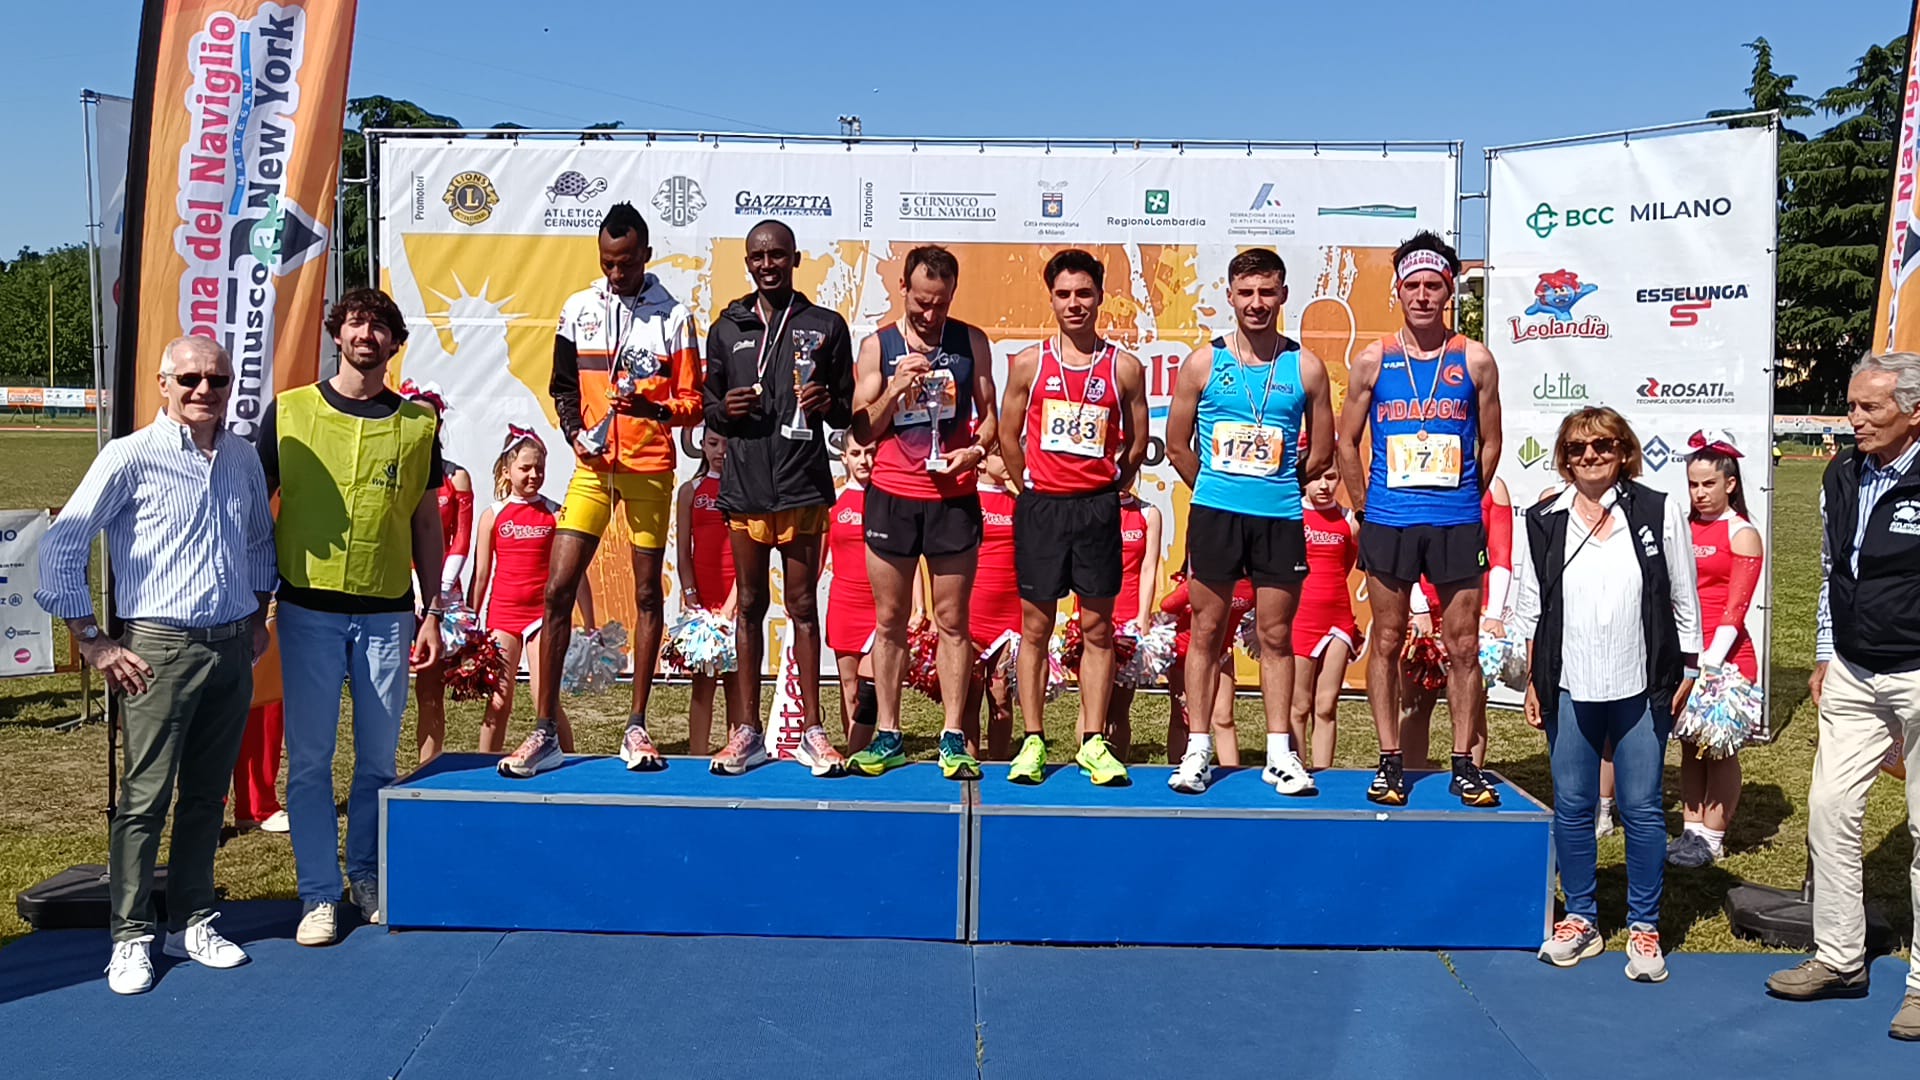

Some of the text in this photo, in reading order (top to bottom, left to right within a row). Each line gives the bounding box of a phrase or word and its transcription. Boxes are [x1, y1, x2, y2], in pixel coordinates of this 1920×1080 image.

[254, 13, 295, 108] York
[189, 16, 242, 185] Naviglio
[234, 68, 252, 187] MARTESANA
[247, 120, 286, 208] New
[455, 173, 487, 185] LIONS
[415, 175, 425, 220] Promotori
[464, 188, 479, 206] L
[674, 177, 685, 222] LEO
[735, 190, 832, 208] GAZZETTA
[863, 182, 873, 228] Patrocinio
[914, 196, 978, 207] CERNUSCO
[544, 208, 603, 218] ATLETICA
[544, 218, 602, 228] CERNUSCO
[914, 207, 996, 218] SUL NAVIGLIO
[1565, 197, 1732, 227] BCC MILANO
[185, 199, 225, 262] del
[1636, 284, 1748, 303] ESSELUNGA
[1508, 315, 1611, 343] Leolandia
[1660, 383, 1725, 397] ROSATI
[1376, 397, 1469, 423] PIDAGGIA
[1051, 417, 1096, 440] 883
[1223, 438, 1269, 460] 175
[1416, 451, 1431, 469] 7
